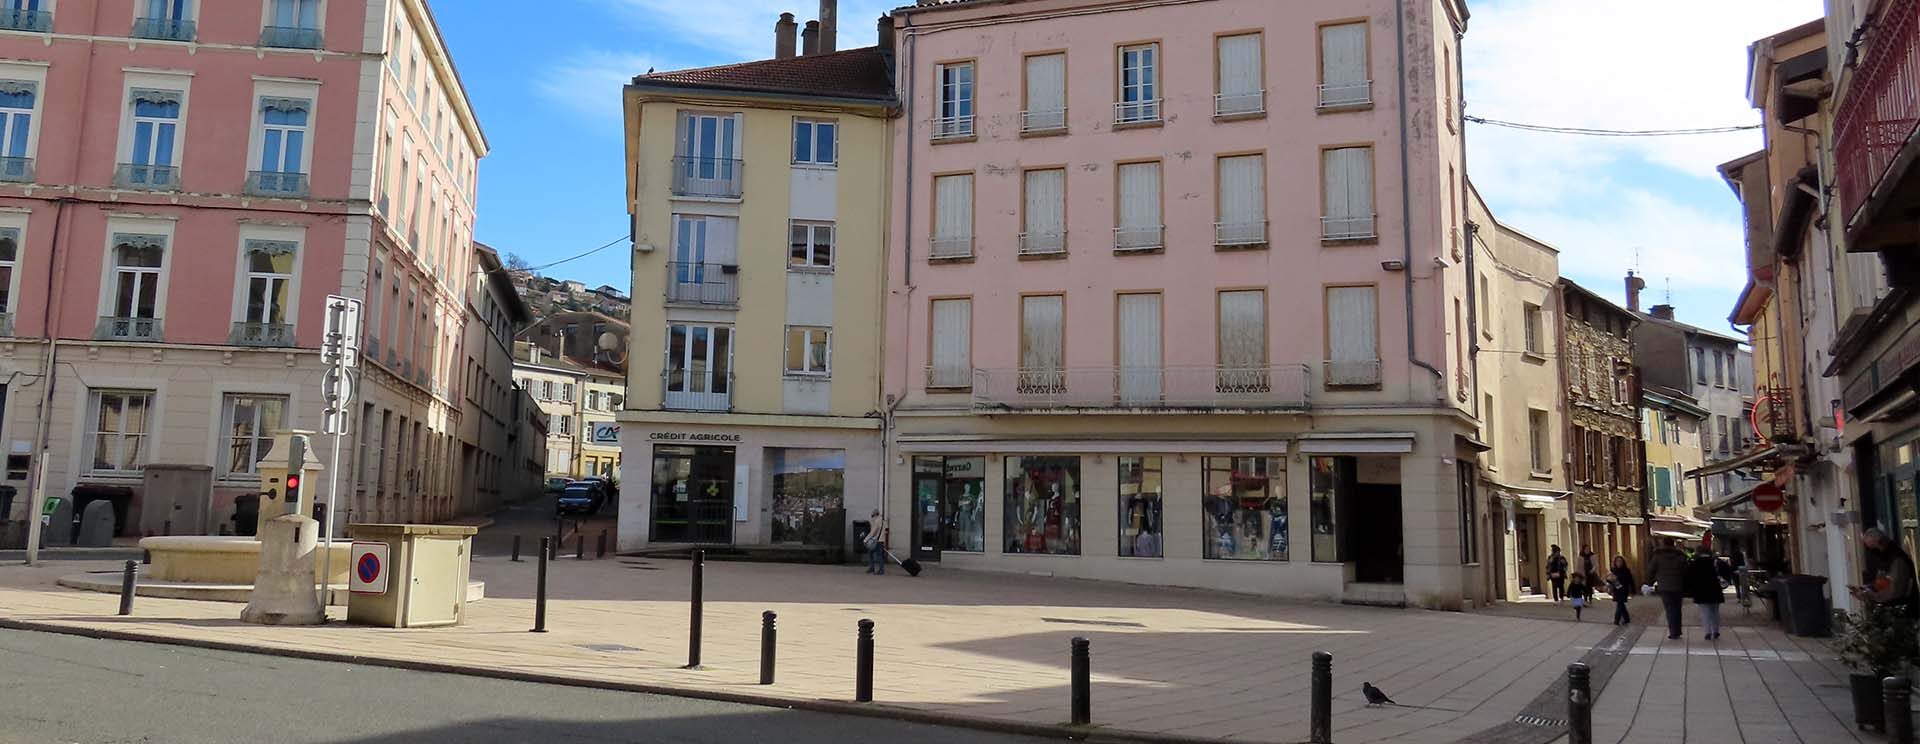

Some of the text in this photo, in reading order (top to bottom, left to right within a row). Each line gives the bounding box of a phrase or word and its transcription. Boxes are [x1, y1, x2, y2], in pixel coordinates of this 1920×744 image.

[596, 426, 619, 439] CA
[649, 431, 741, 442] CRÉDIT AGRICOLE
